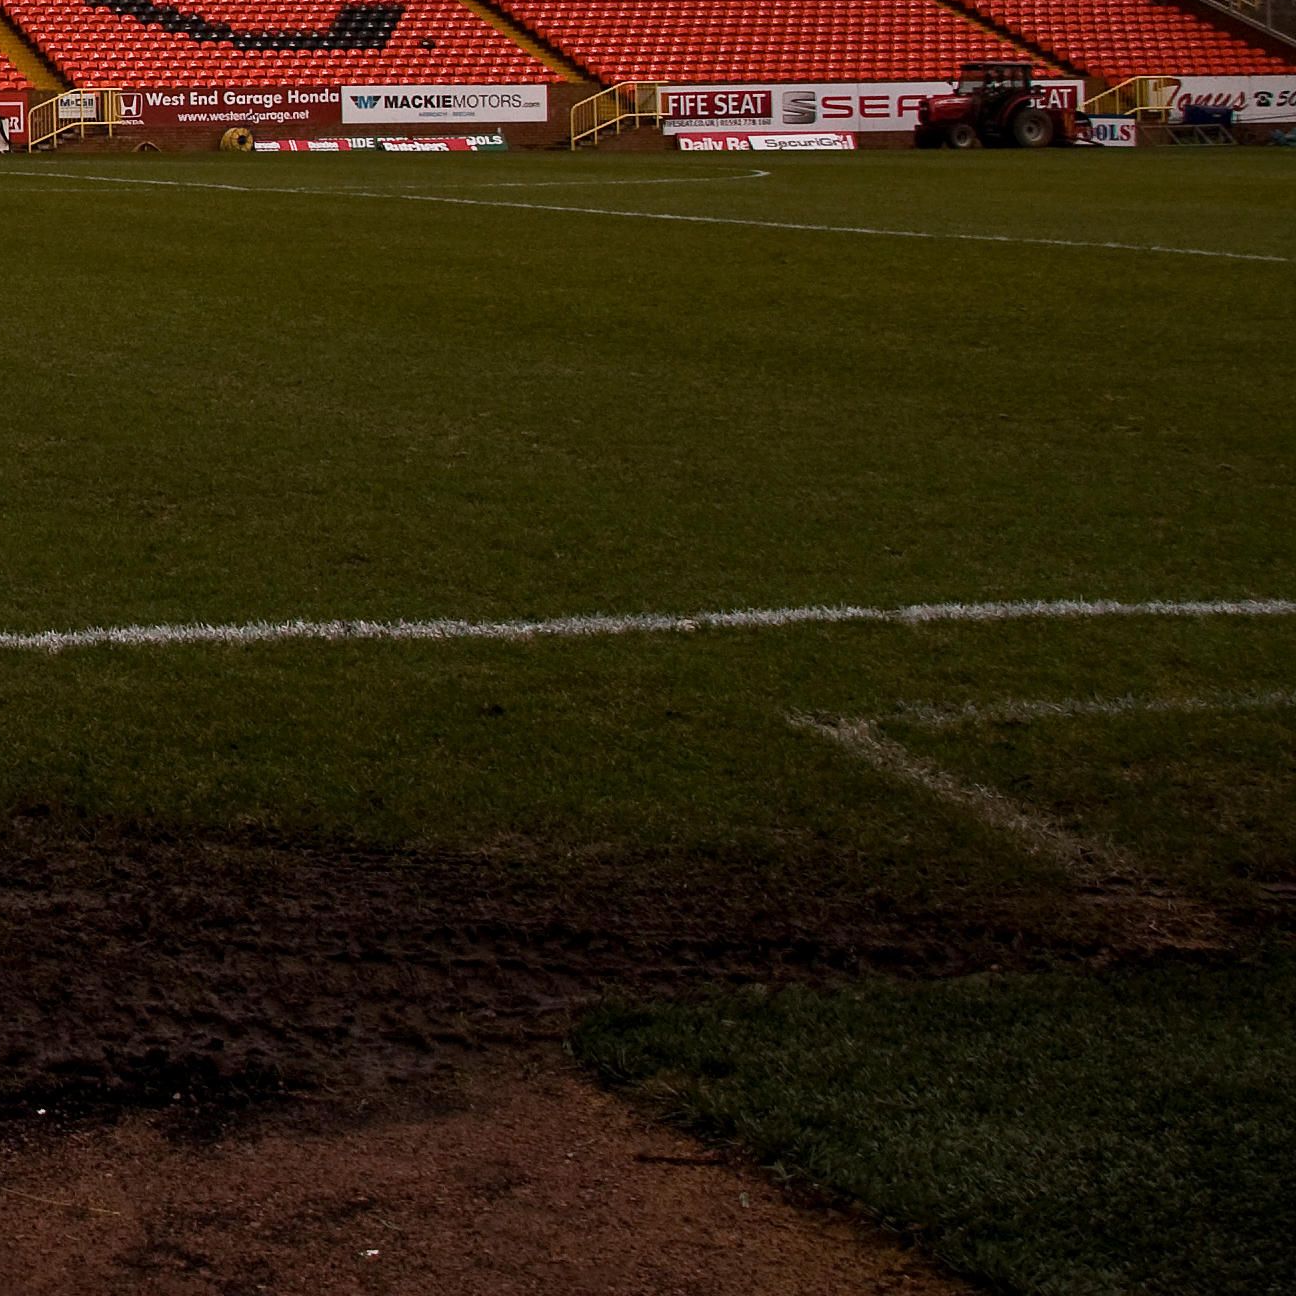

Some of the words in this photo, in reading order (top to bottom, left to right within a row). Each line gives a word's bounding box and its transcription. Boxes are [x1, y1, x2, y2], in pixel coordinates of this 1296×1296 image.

[145, 92, 185, 106] West
[190, 91, 217, 105] End
[223, 90, 283, 108] Garage
[287, 89, 339, 104] Honda
[668, 94, 709, 116] FIFE
[714, 93, 767, 115] SEAT
[822, 95, 928, 118] SEA
[177, 109, 310, 123] www.westendgarage.net
